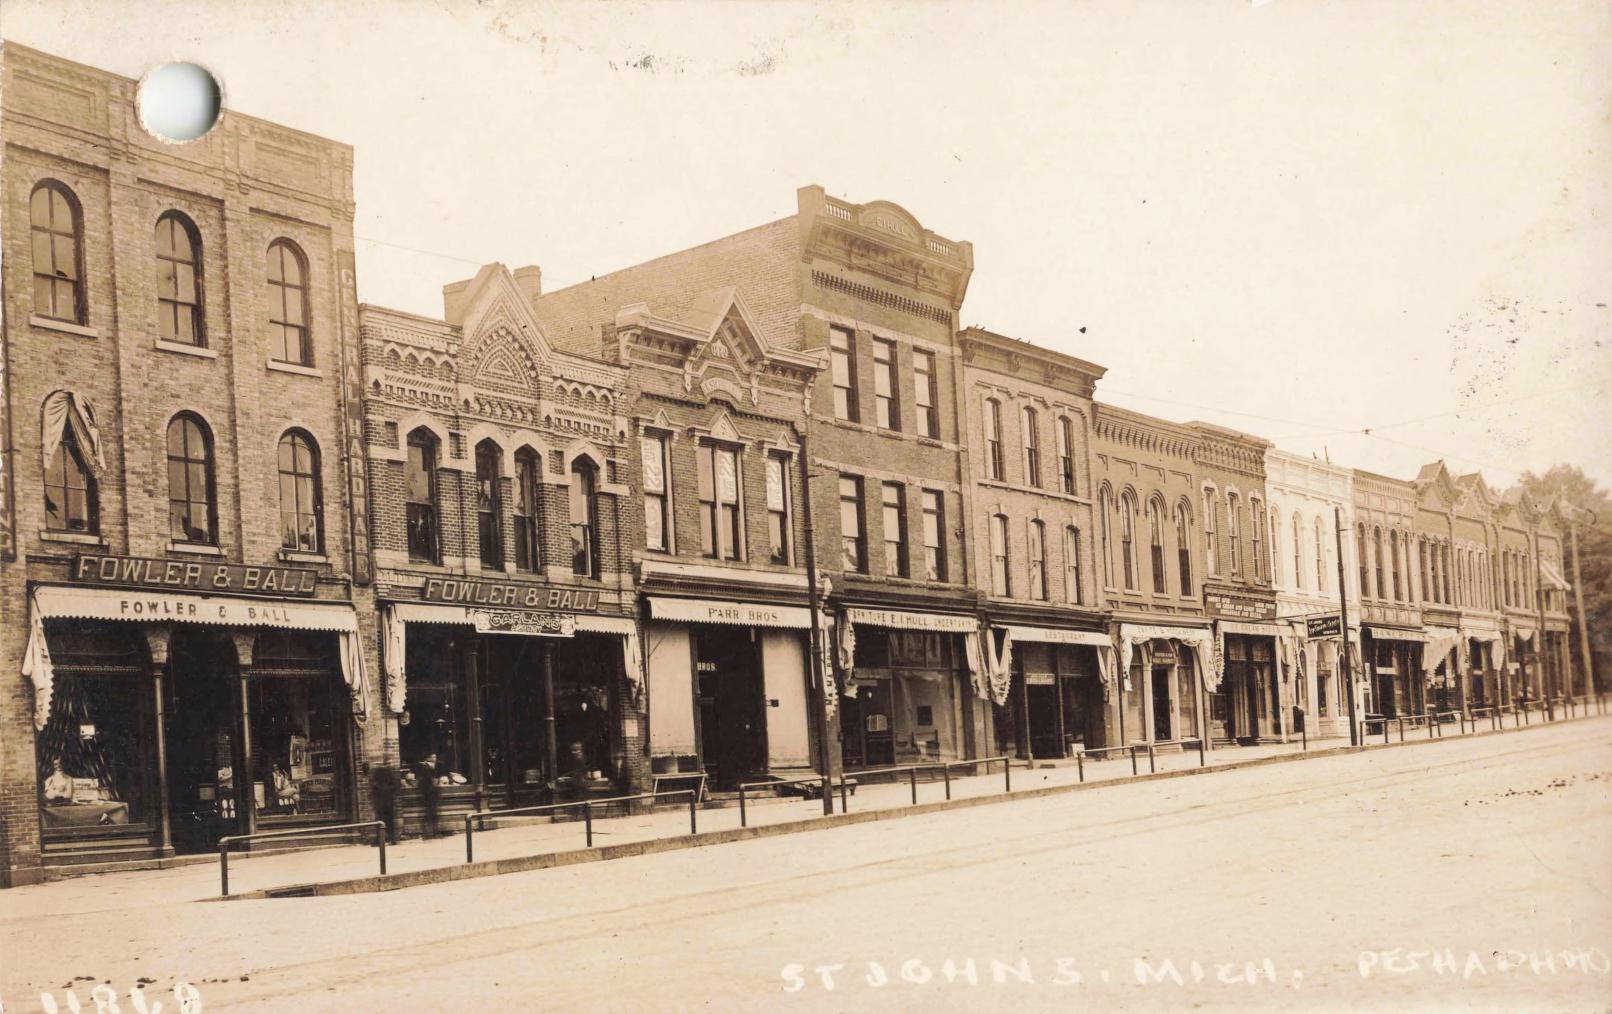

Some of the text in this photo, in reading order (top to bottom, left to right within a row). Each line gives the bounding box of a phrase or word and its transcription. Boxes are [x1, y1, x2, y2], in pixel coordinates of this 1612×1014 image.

[342, 268, 360, 403] GENERAL
[350, 418, 368, 573] HARDWARE
[78, 556, 315, 592] FOWLER & BALL
[425, 579, 597, 610] FOWLER & BALL
[120, 600, 291, 623] FOWLER & BALL
[489, 612, 561, 631] GARLAND
[708, 606, 740, 620] PARR
[906, 616, 929, 626] HULL
